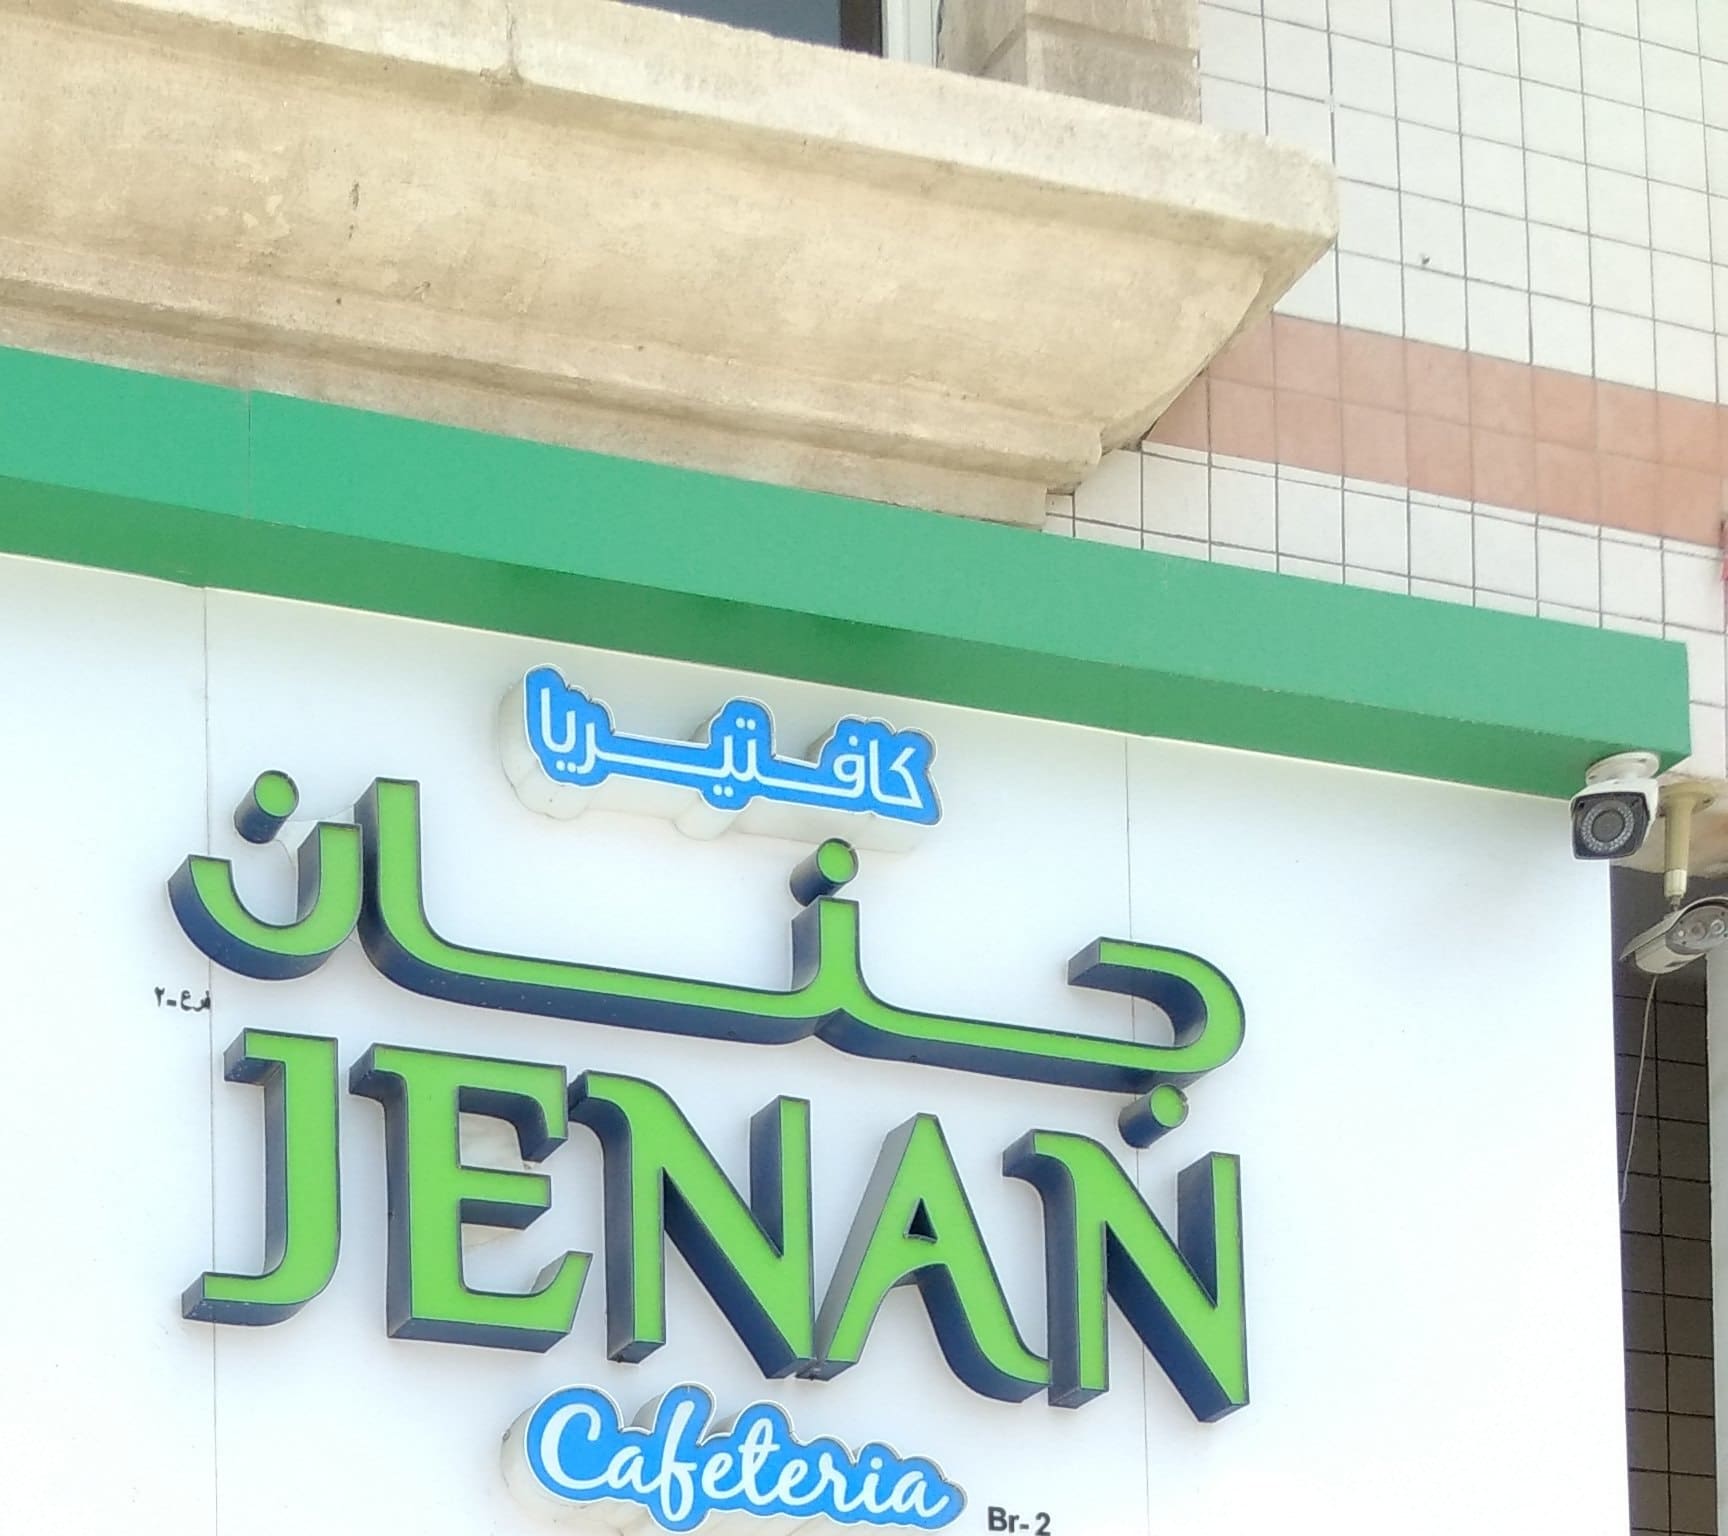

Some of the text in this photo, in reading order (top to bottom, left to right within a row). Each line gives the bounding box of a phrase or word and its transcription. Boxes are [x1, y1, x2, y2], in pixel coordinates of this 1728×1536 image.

[539, 686, 924, 809] كافتيريا
[169, 770, 1247, 1148] جنان
[182, 1027, 1249, 1423] JENAN
[539, 1399, 950, 1522] Cafeteria
